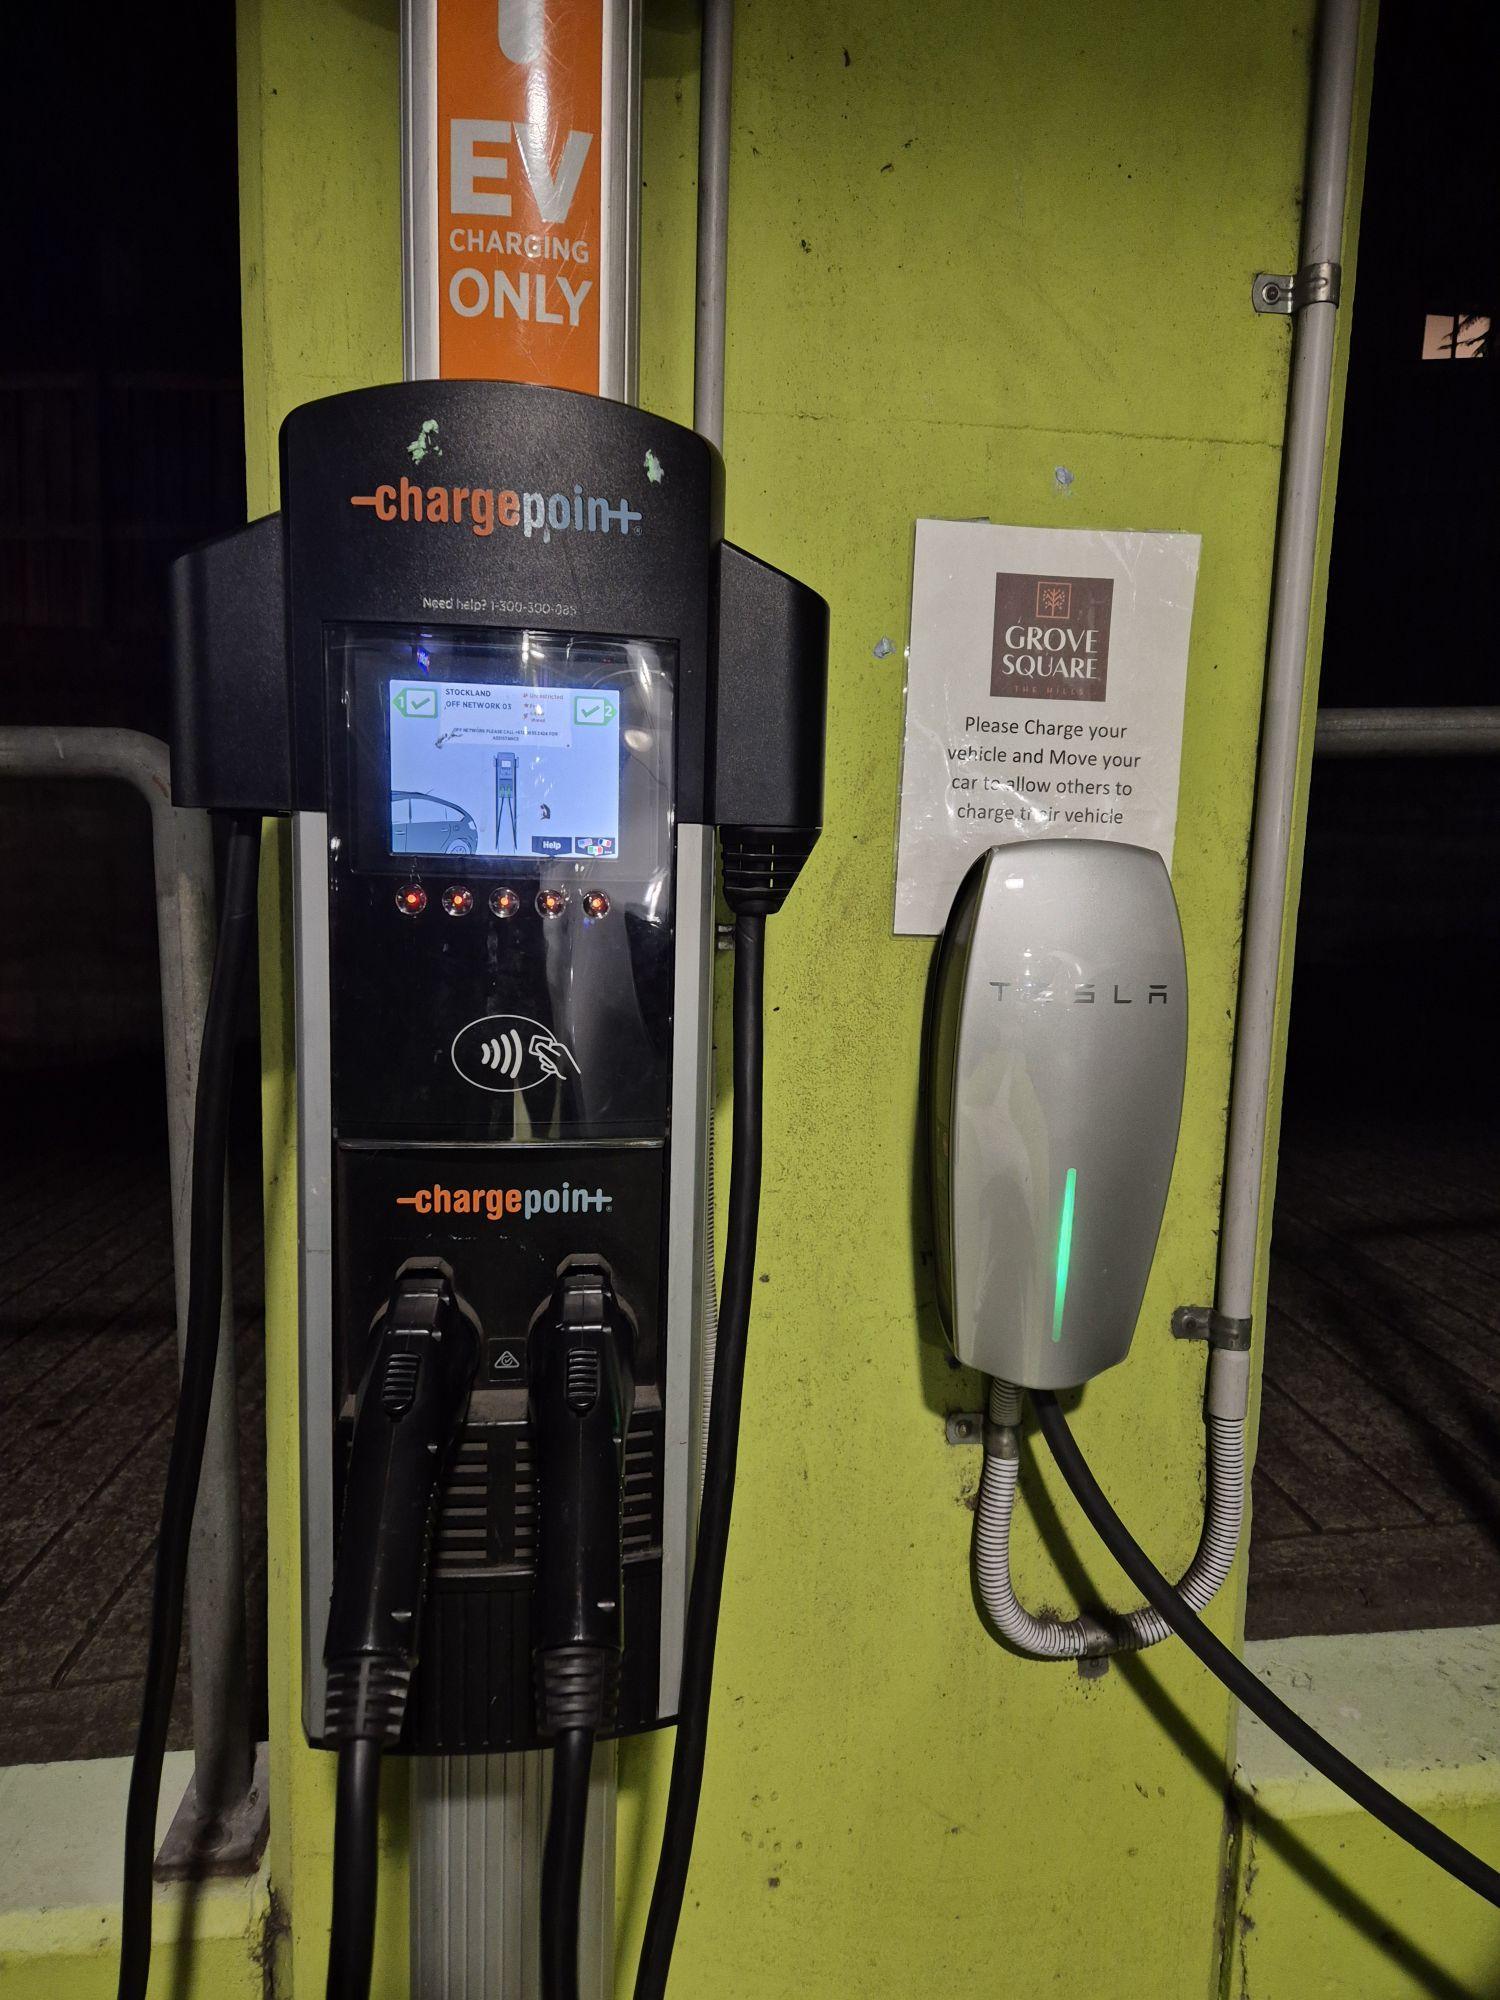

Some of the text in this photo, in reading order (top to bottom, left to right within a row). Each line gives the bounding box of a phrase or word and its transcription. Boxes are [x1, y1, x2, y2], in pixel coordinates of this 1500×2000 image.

[450, 118, 594, 224] EV
[449, 228, 589, 263] CHARGING
[449, 267, 593, 327] ONLY
[422, 597, 453, 611] Need
[456, 599, 487, 612] help?
[1005, 625, 1099, 654] GROVE
[1002, 654, 1097, 680] SQUARE
[445, 688, 491, 698] STOCKLAND
[446, 701, 512, 711] OFF NETWORK 03
[965, 716, 1127, 740] Please Charge your
[948, 746, 1141, 770] vehicle and Move your
[952, 776, 976, 790] car
[1006, 776, 1051, 793] allow
[1056, 779, 1110, 796] others
[1115, 781, 1133, 796] to
[957, 803, 1014, 822] charge
[1065, 808, 1123, 824] vehicle
[542, 840, 562, 852] Help
[989, 981, 1168, 1004] TSLA
